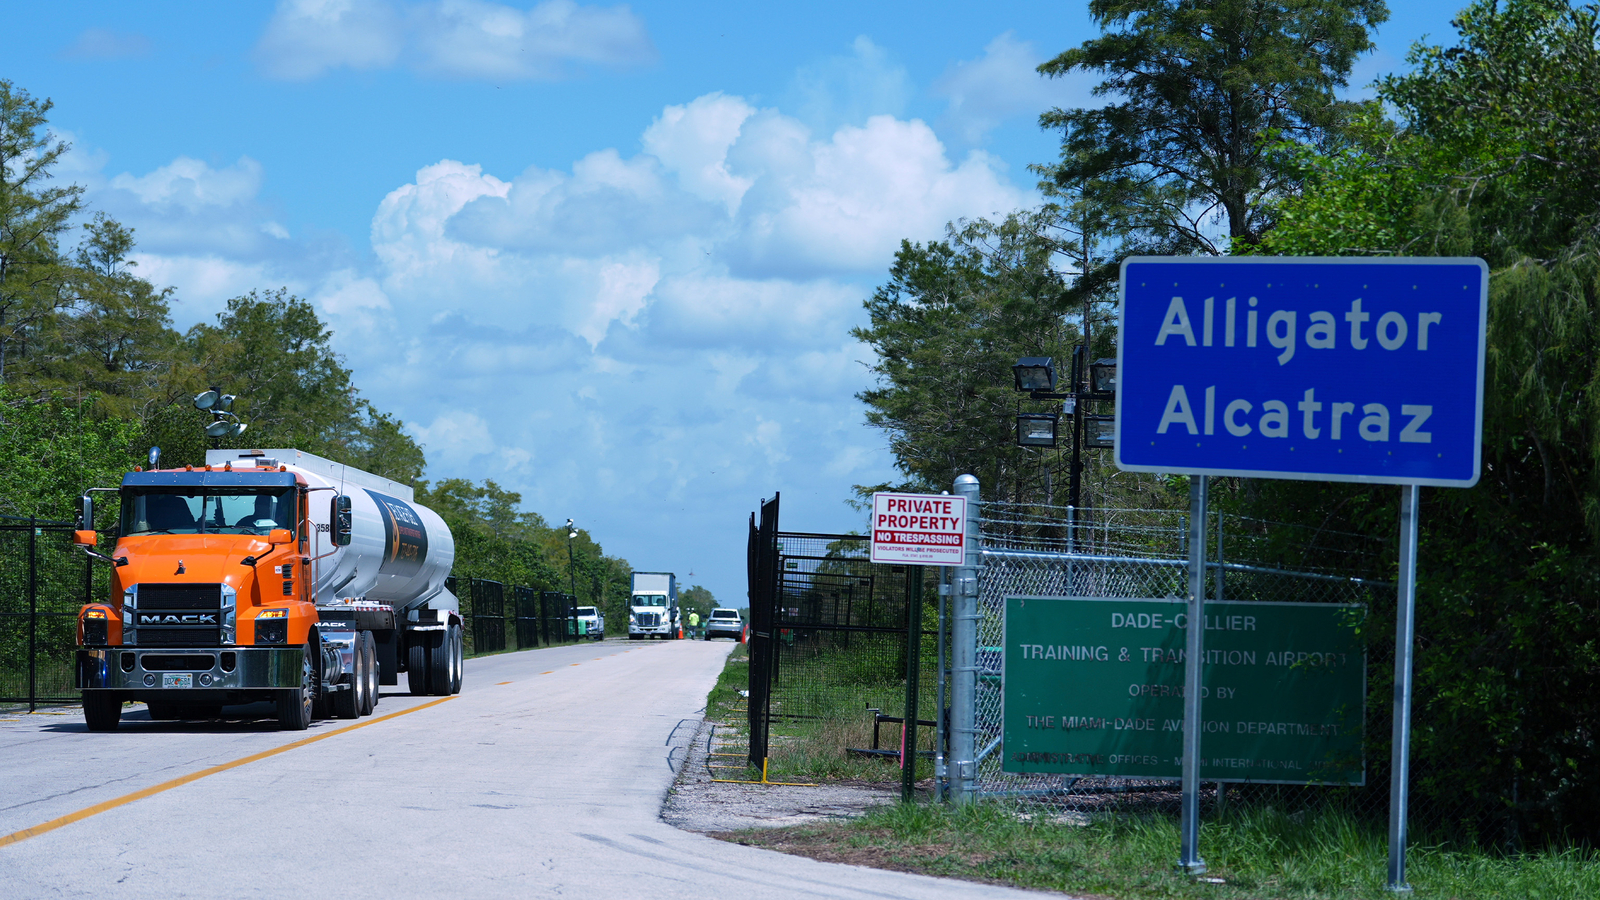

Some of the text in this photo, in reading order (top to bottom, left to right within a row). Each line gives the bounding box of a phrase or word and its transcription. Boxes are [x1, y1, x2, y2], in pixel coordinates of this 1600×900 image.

[1154, 296, 1443, 366] Alligator
[1155, 384, 1433, 444] Alcatraz
[888, 499, 952, 514] PRIVATE
[878, 514, 960, 530] PROPERTY
[877, 532, 960, 545] NO TRESPASSING
[140, 614, 217, 625] MACK
[1111, 613, 1256, 631] DADE-CLLIER
[1019, 644, 1109, 662] TRAINING
[1118, 647, 1131, 662] &
[1140, 647, 1256, 665] TRANITION
[1129, 684, 1236, 699] OPERATD BY
[1026, 715, 1055, 729] THE
[1062, 716, 1155, 731] MIAMI-DADE
[1237, 722, 1341, 736] DEPARTMENT
[1109, 754, 1159, 765] OFFICES
[1212, 757, 1302, 770] INTERNATIONAL
